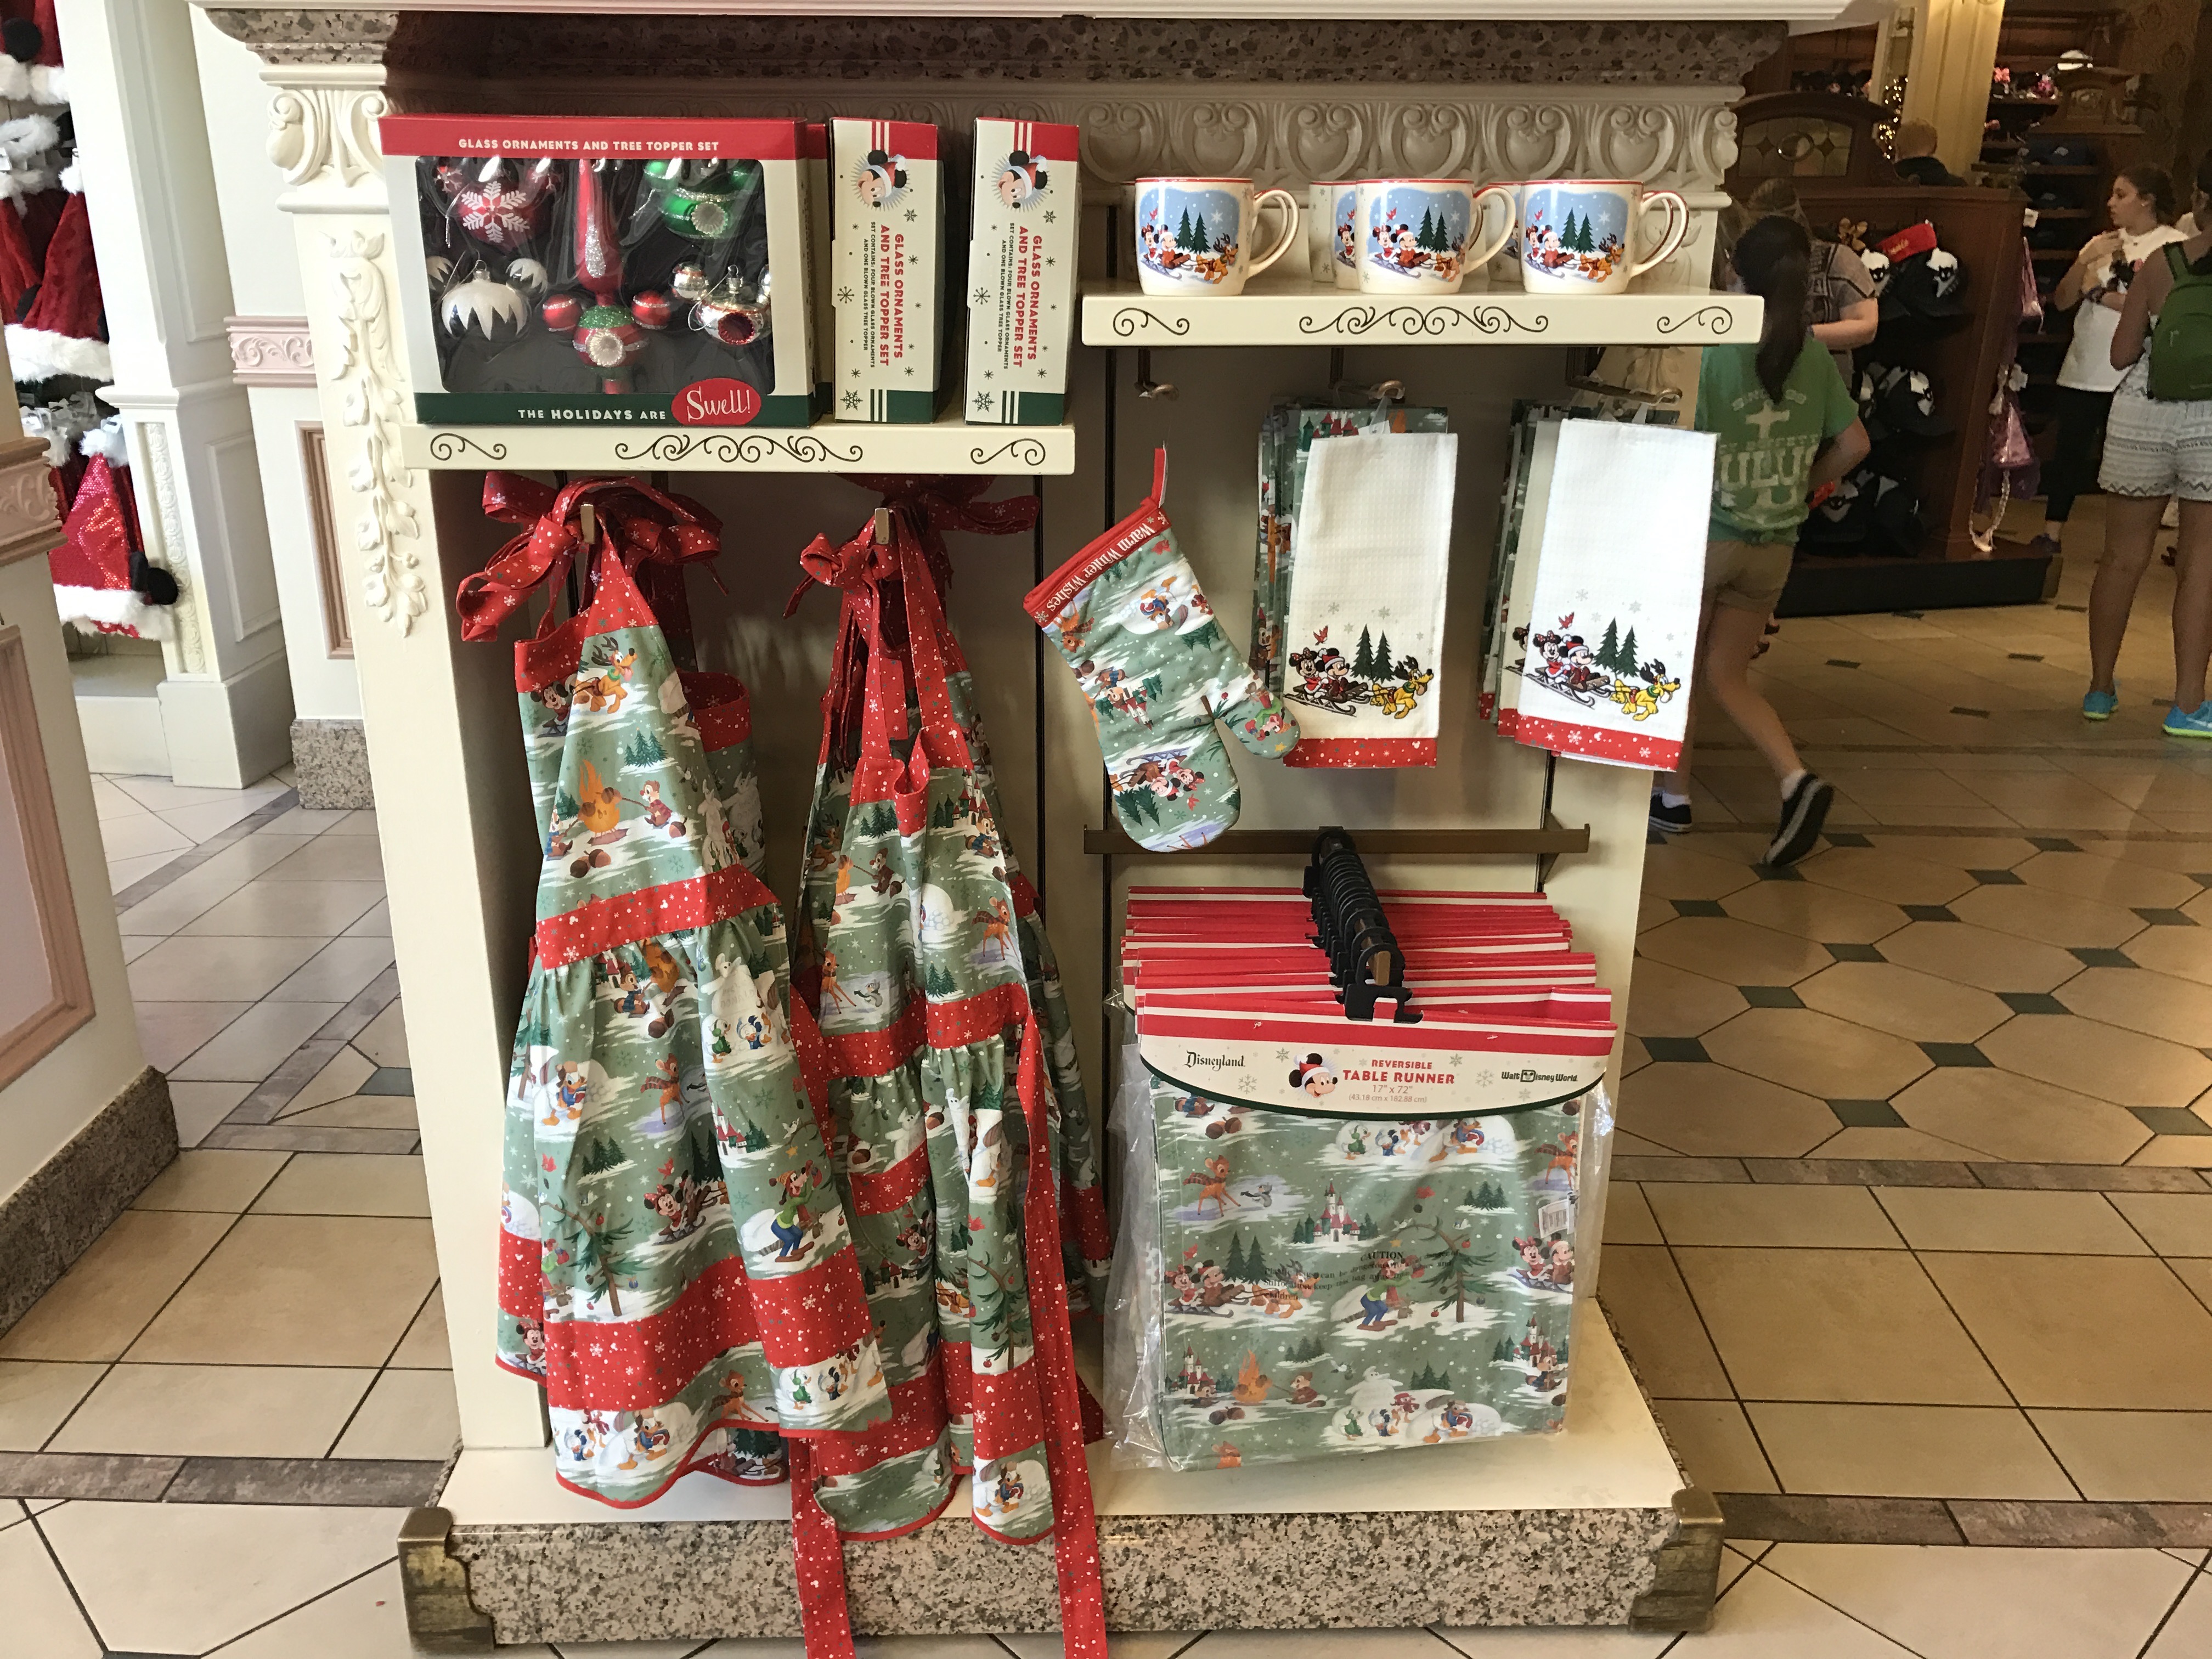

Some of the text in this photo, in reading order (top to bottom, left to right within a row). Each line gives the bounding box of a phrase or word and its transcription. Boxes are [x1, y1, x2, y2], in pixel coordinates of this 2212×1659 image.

[458, 139, 719, 151] GLASS ORNAMENTS AND TREE TOPPER SET
[879, 224, 890, 366] AND TREE TOPPER SET
[893, 234, 904, 358] GLASS ORNAMENTS
[1013, 225, 1029, 368] AND TREE TOPPER SET
[1027, 235, 1042, 360] GLASS ORNAMENTS
[518, 386, 751, 422] THE HOLIDAYS ARE Swell!
[1046, 523, 1156, 612] Warm Winter Wishes
[1182, 1049, 1244, 1071] Disneyland
[1372, 1059, 1432, 1069] REVERSIBLE
[1343, 1070, 1455, 1084] TABLE RUNNER
[1501, 1071, 1520, 1080] Walt
[1520, 1069, 1555, 1082] Disney
[1373, 1085, 1387, 1093] 17"
[1398, 1086, 1413, 1094] 72"
[1361, 1251, 1404, 1261] CAUTION
